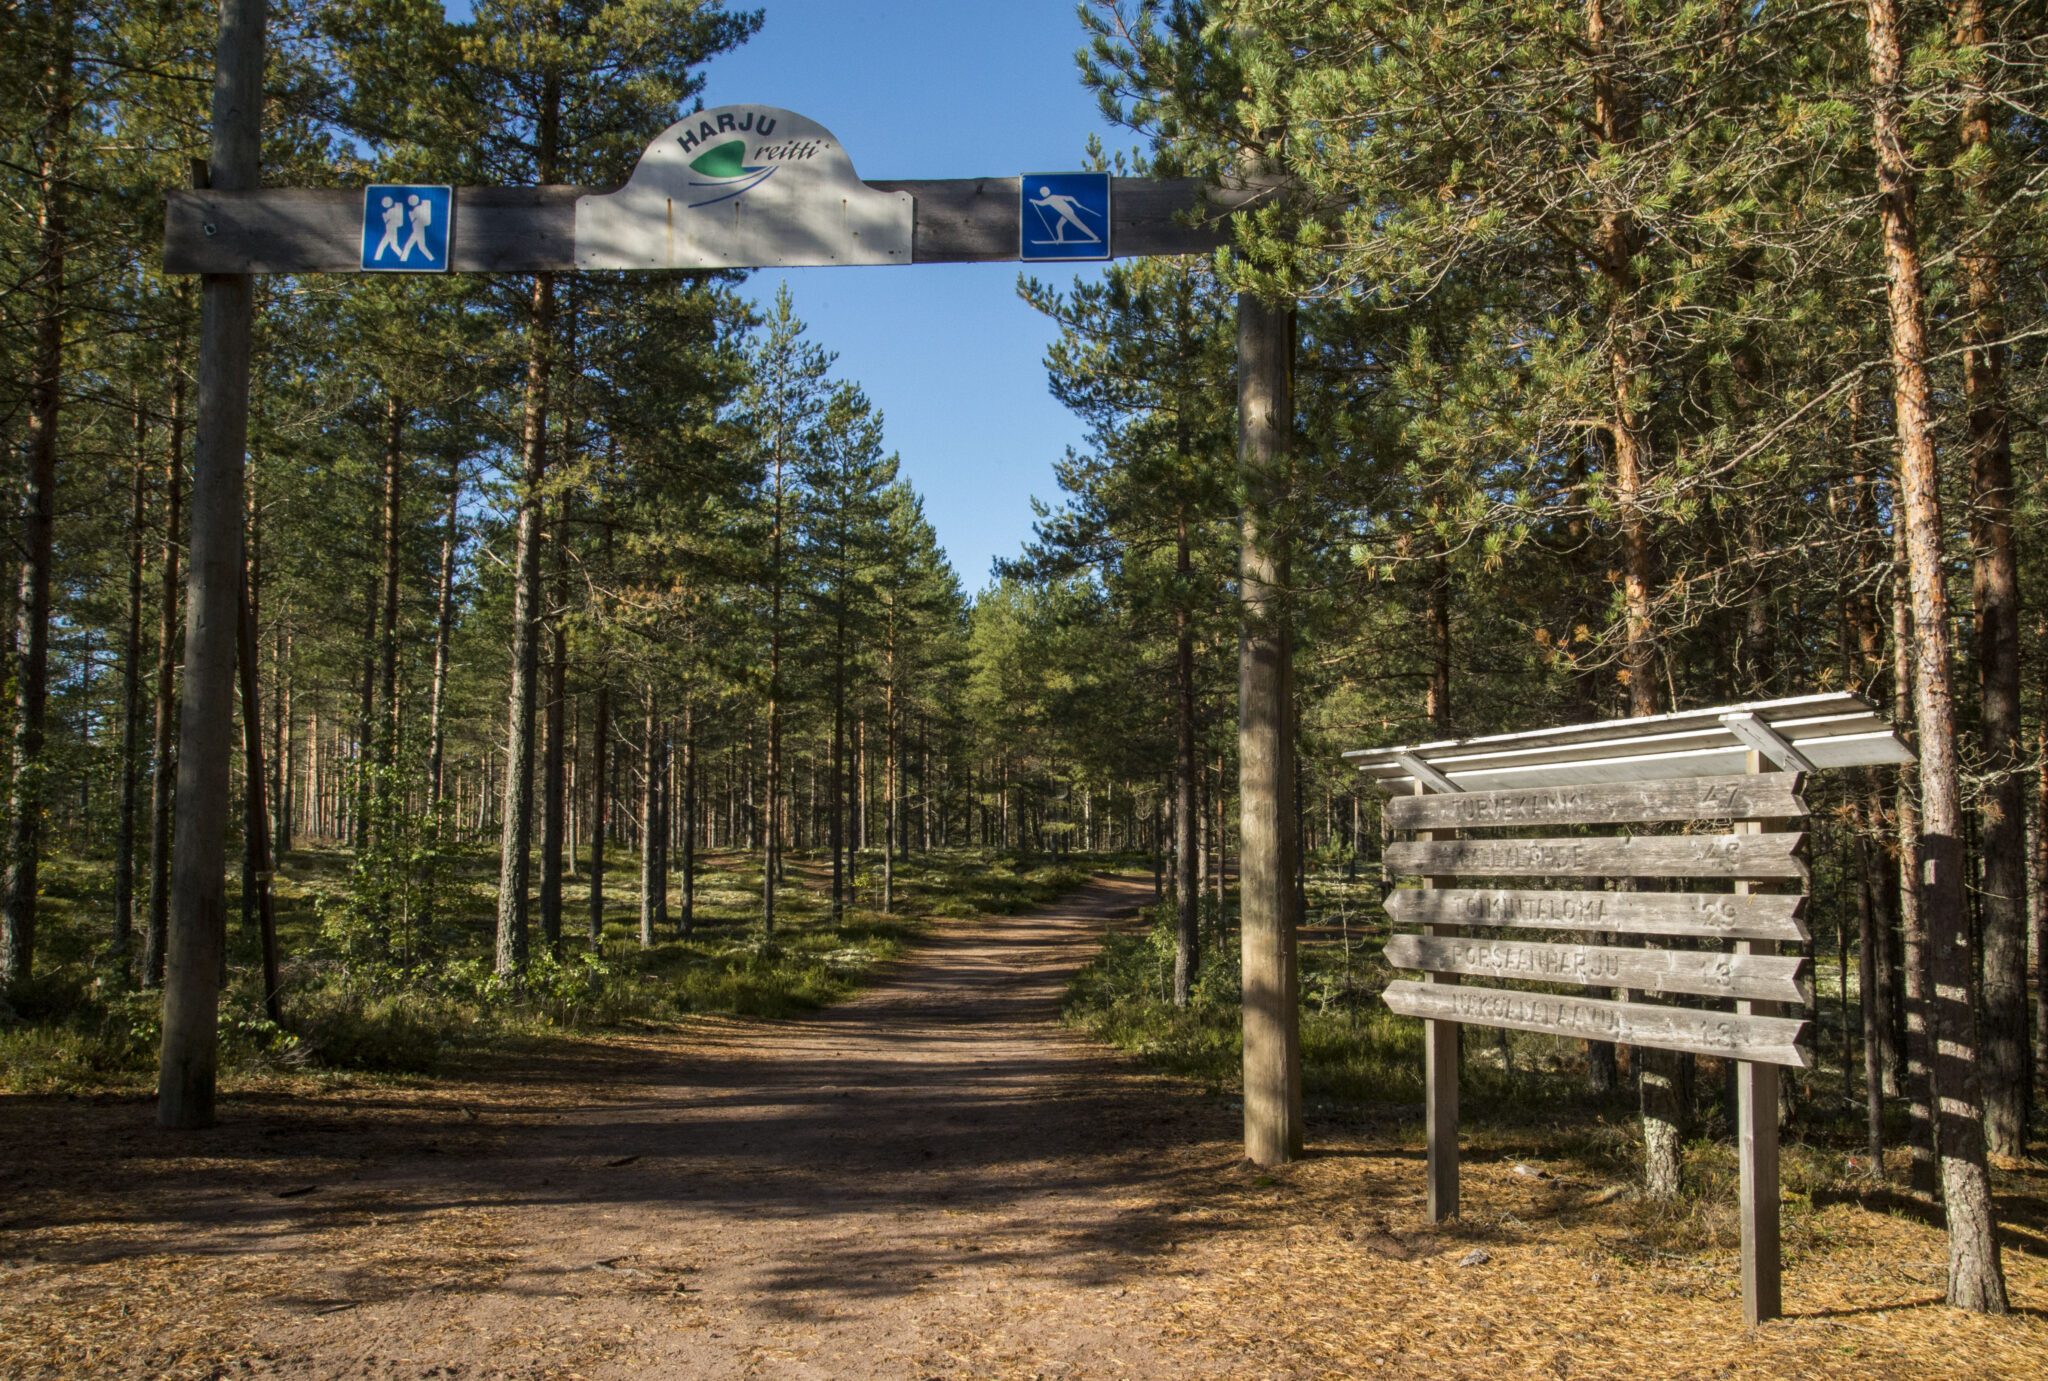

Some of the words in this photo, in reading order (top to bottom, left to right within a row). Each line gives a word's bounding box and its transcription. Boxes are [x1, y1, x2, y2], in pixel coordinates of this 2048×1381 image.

[676, 112, 776, 154] HARJU
[754, 139, 821, 160] reitti
[1452, 945, 1619, 977] PORSAANHARJU
